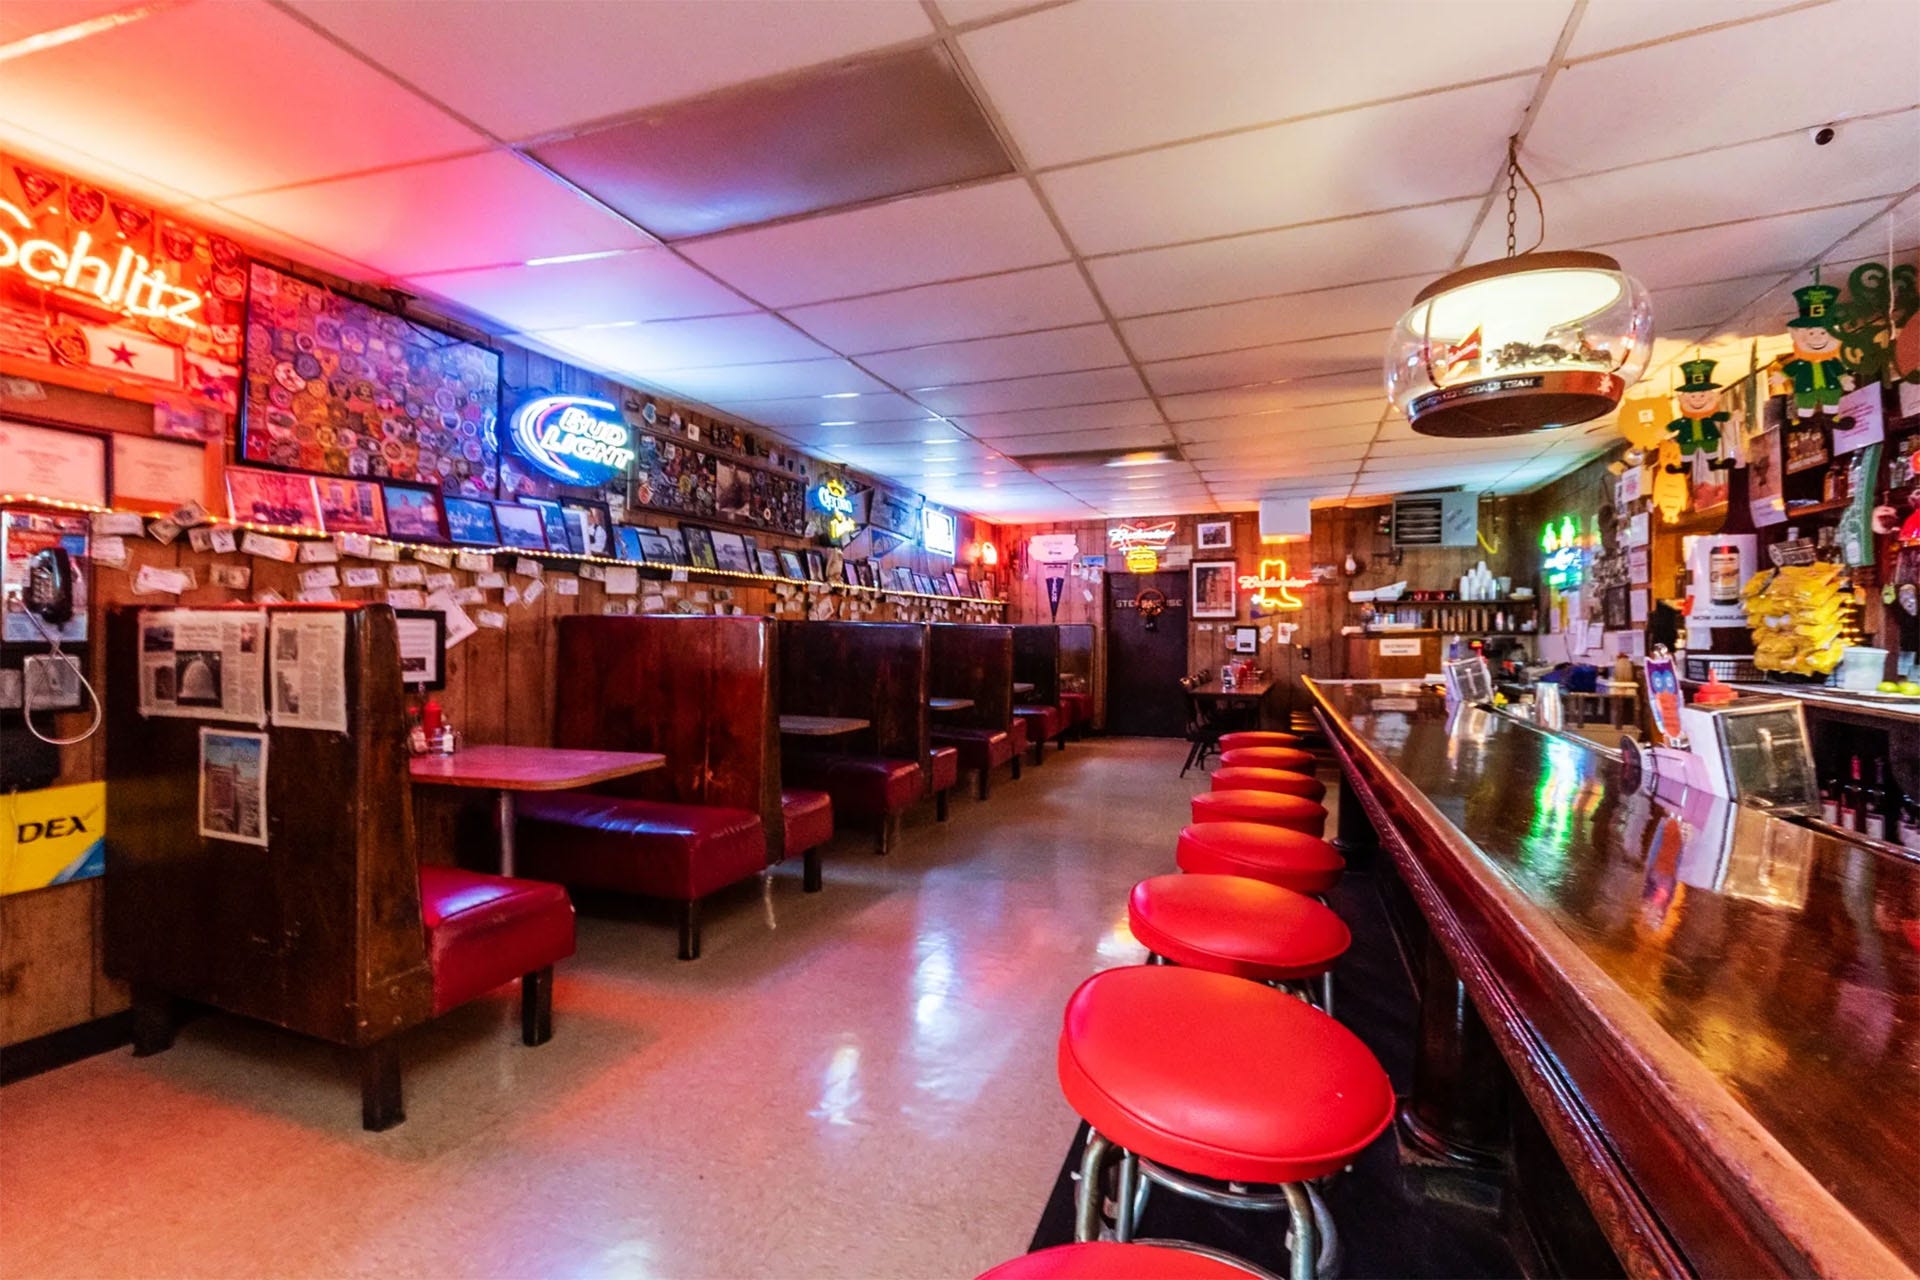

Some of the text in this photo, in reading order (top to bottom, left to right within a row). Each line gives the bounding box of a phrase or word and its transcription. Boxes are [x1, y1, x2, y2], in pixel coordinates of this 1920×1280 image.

[0, 196, 201, 328] Schlitz
[1505, 378, 1534, 389] TEAM
[818, 486, 853, 513] Corona
[1108, 528, 1175, 542] Budweiser
[1238, 575, 1312, 590] Budweiser
[17, 815, 88, 844] DEX
